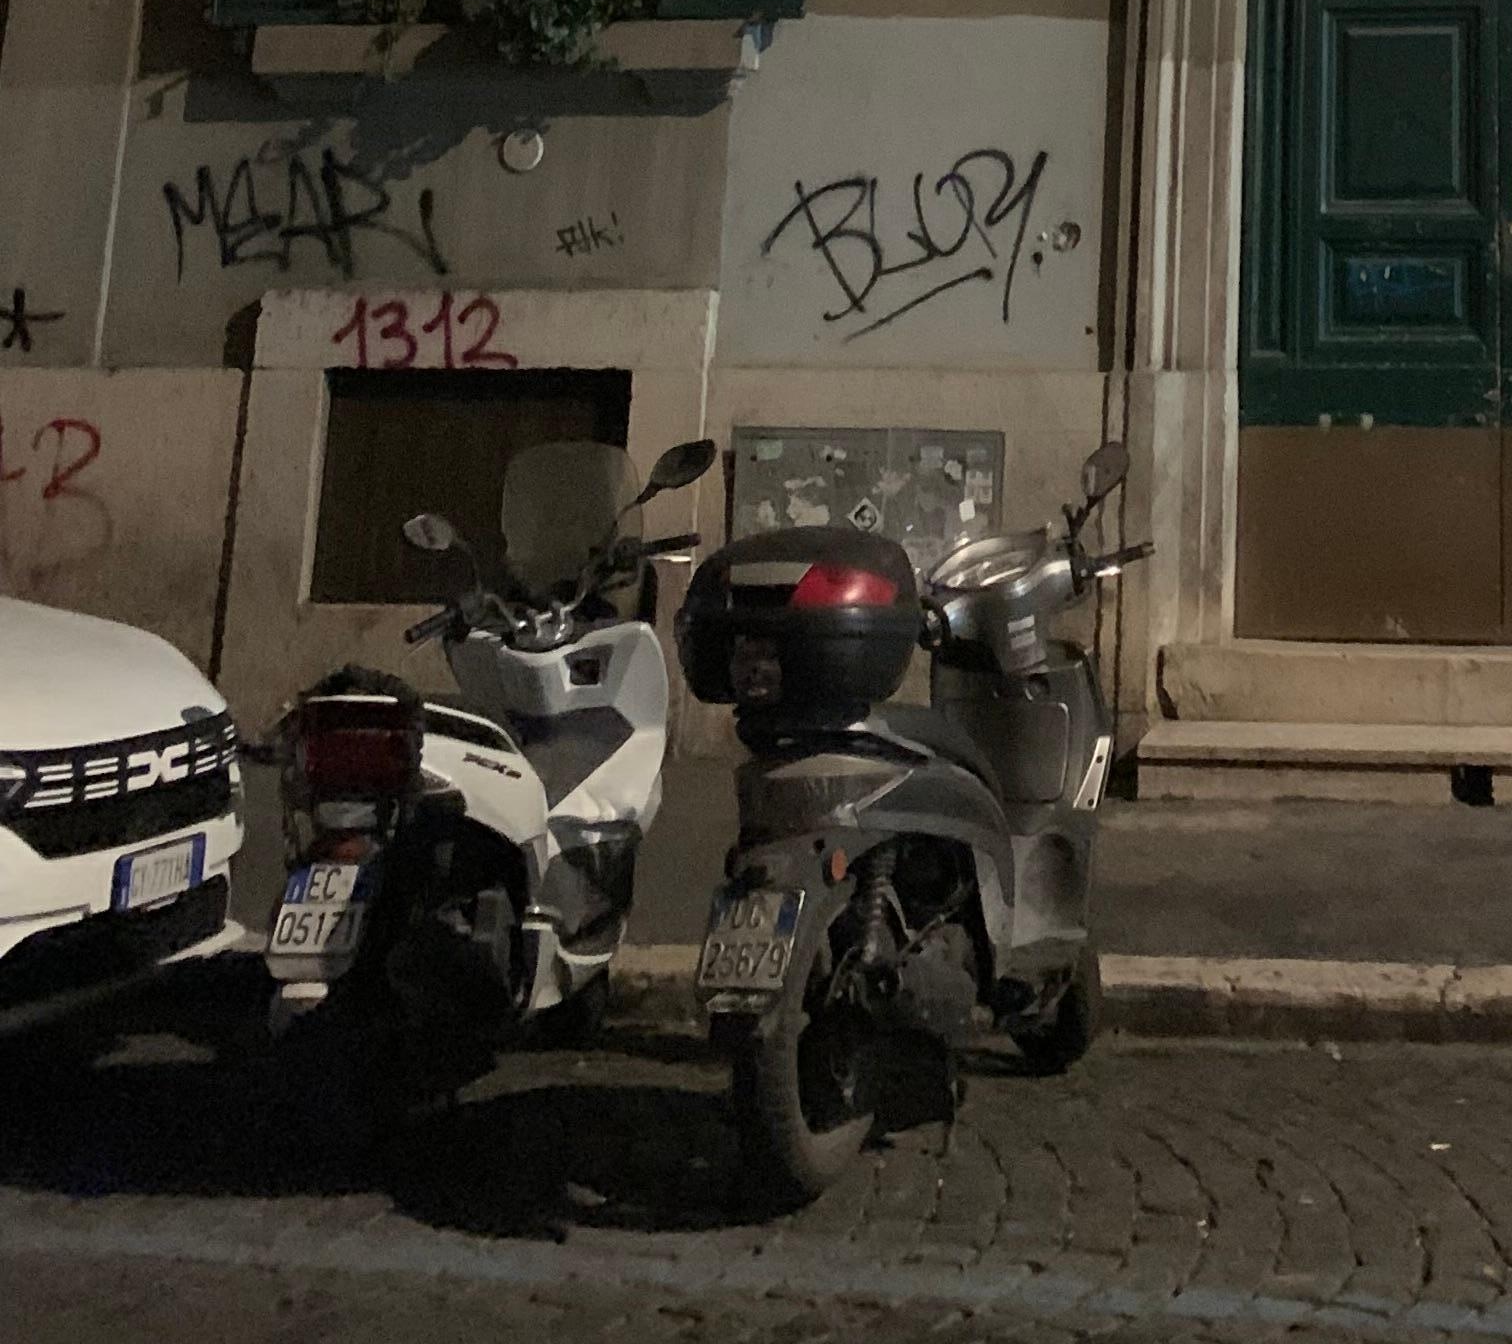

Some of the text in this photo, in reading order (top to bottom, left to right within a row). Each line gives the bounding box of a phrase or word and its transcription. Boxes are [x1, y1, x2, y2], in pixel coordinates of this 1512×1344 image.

[331, 289, 519, 370] 1312
[308, 867, 342, 900] EC
[702, 942, 785, 979] 25679
